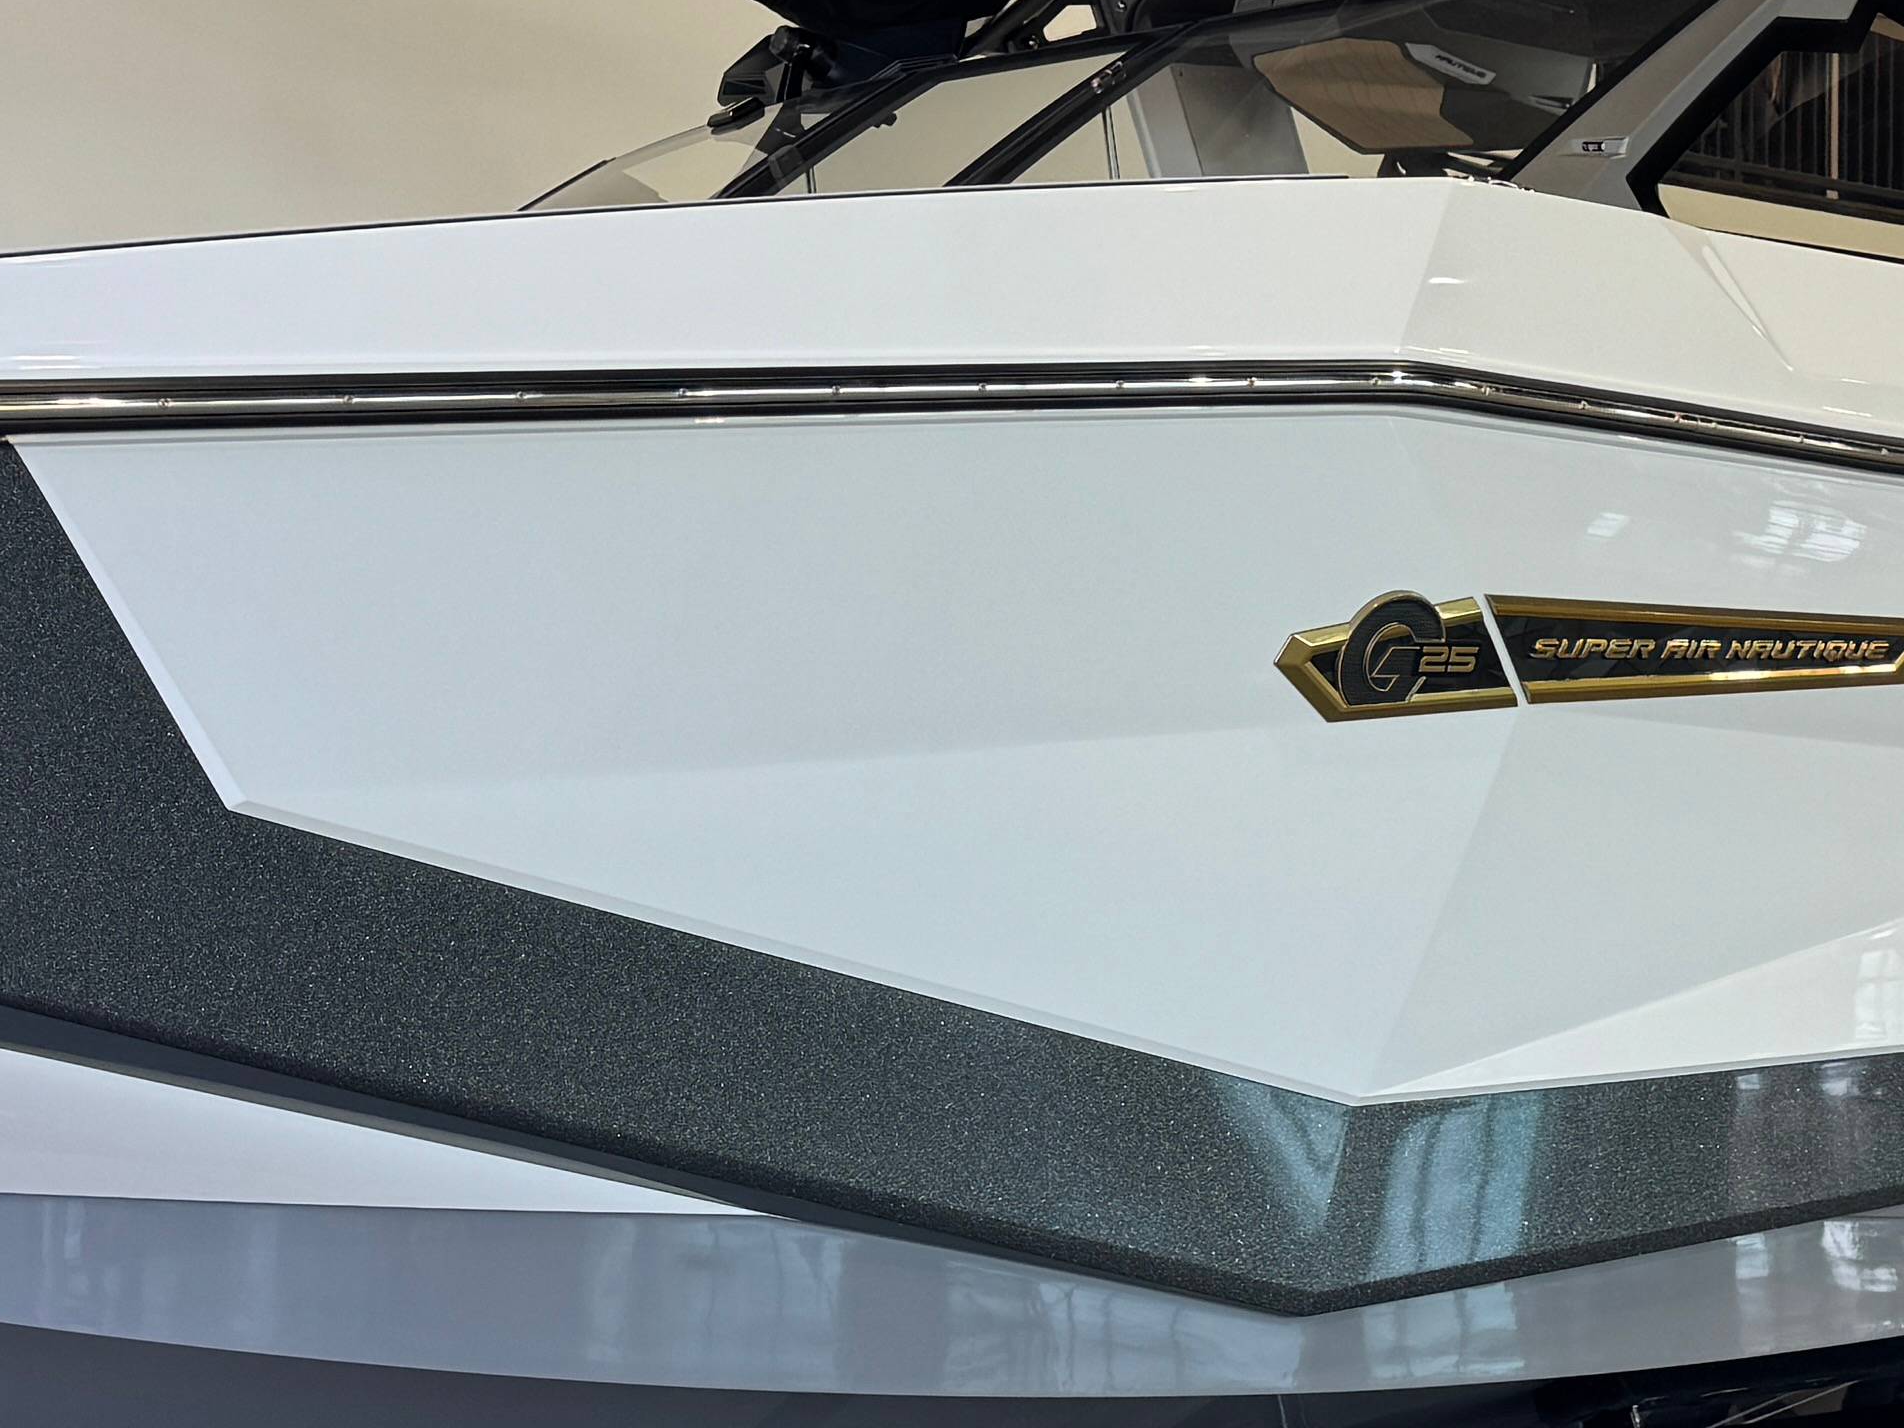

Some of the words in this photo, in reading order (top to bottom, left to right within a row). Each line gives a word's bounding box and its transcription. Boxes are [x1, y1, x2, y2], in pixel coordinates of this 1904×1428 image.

[1529, 638, 1657, 661] SUPER
[1660, 639, 1723, 661] AIR
[1725, 639, 1891, 663] NAUTIQUE
